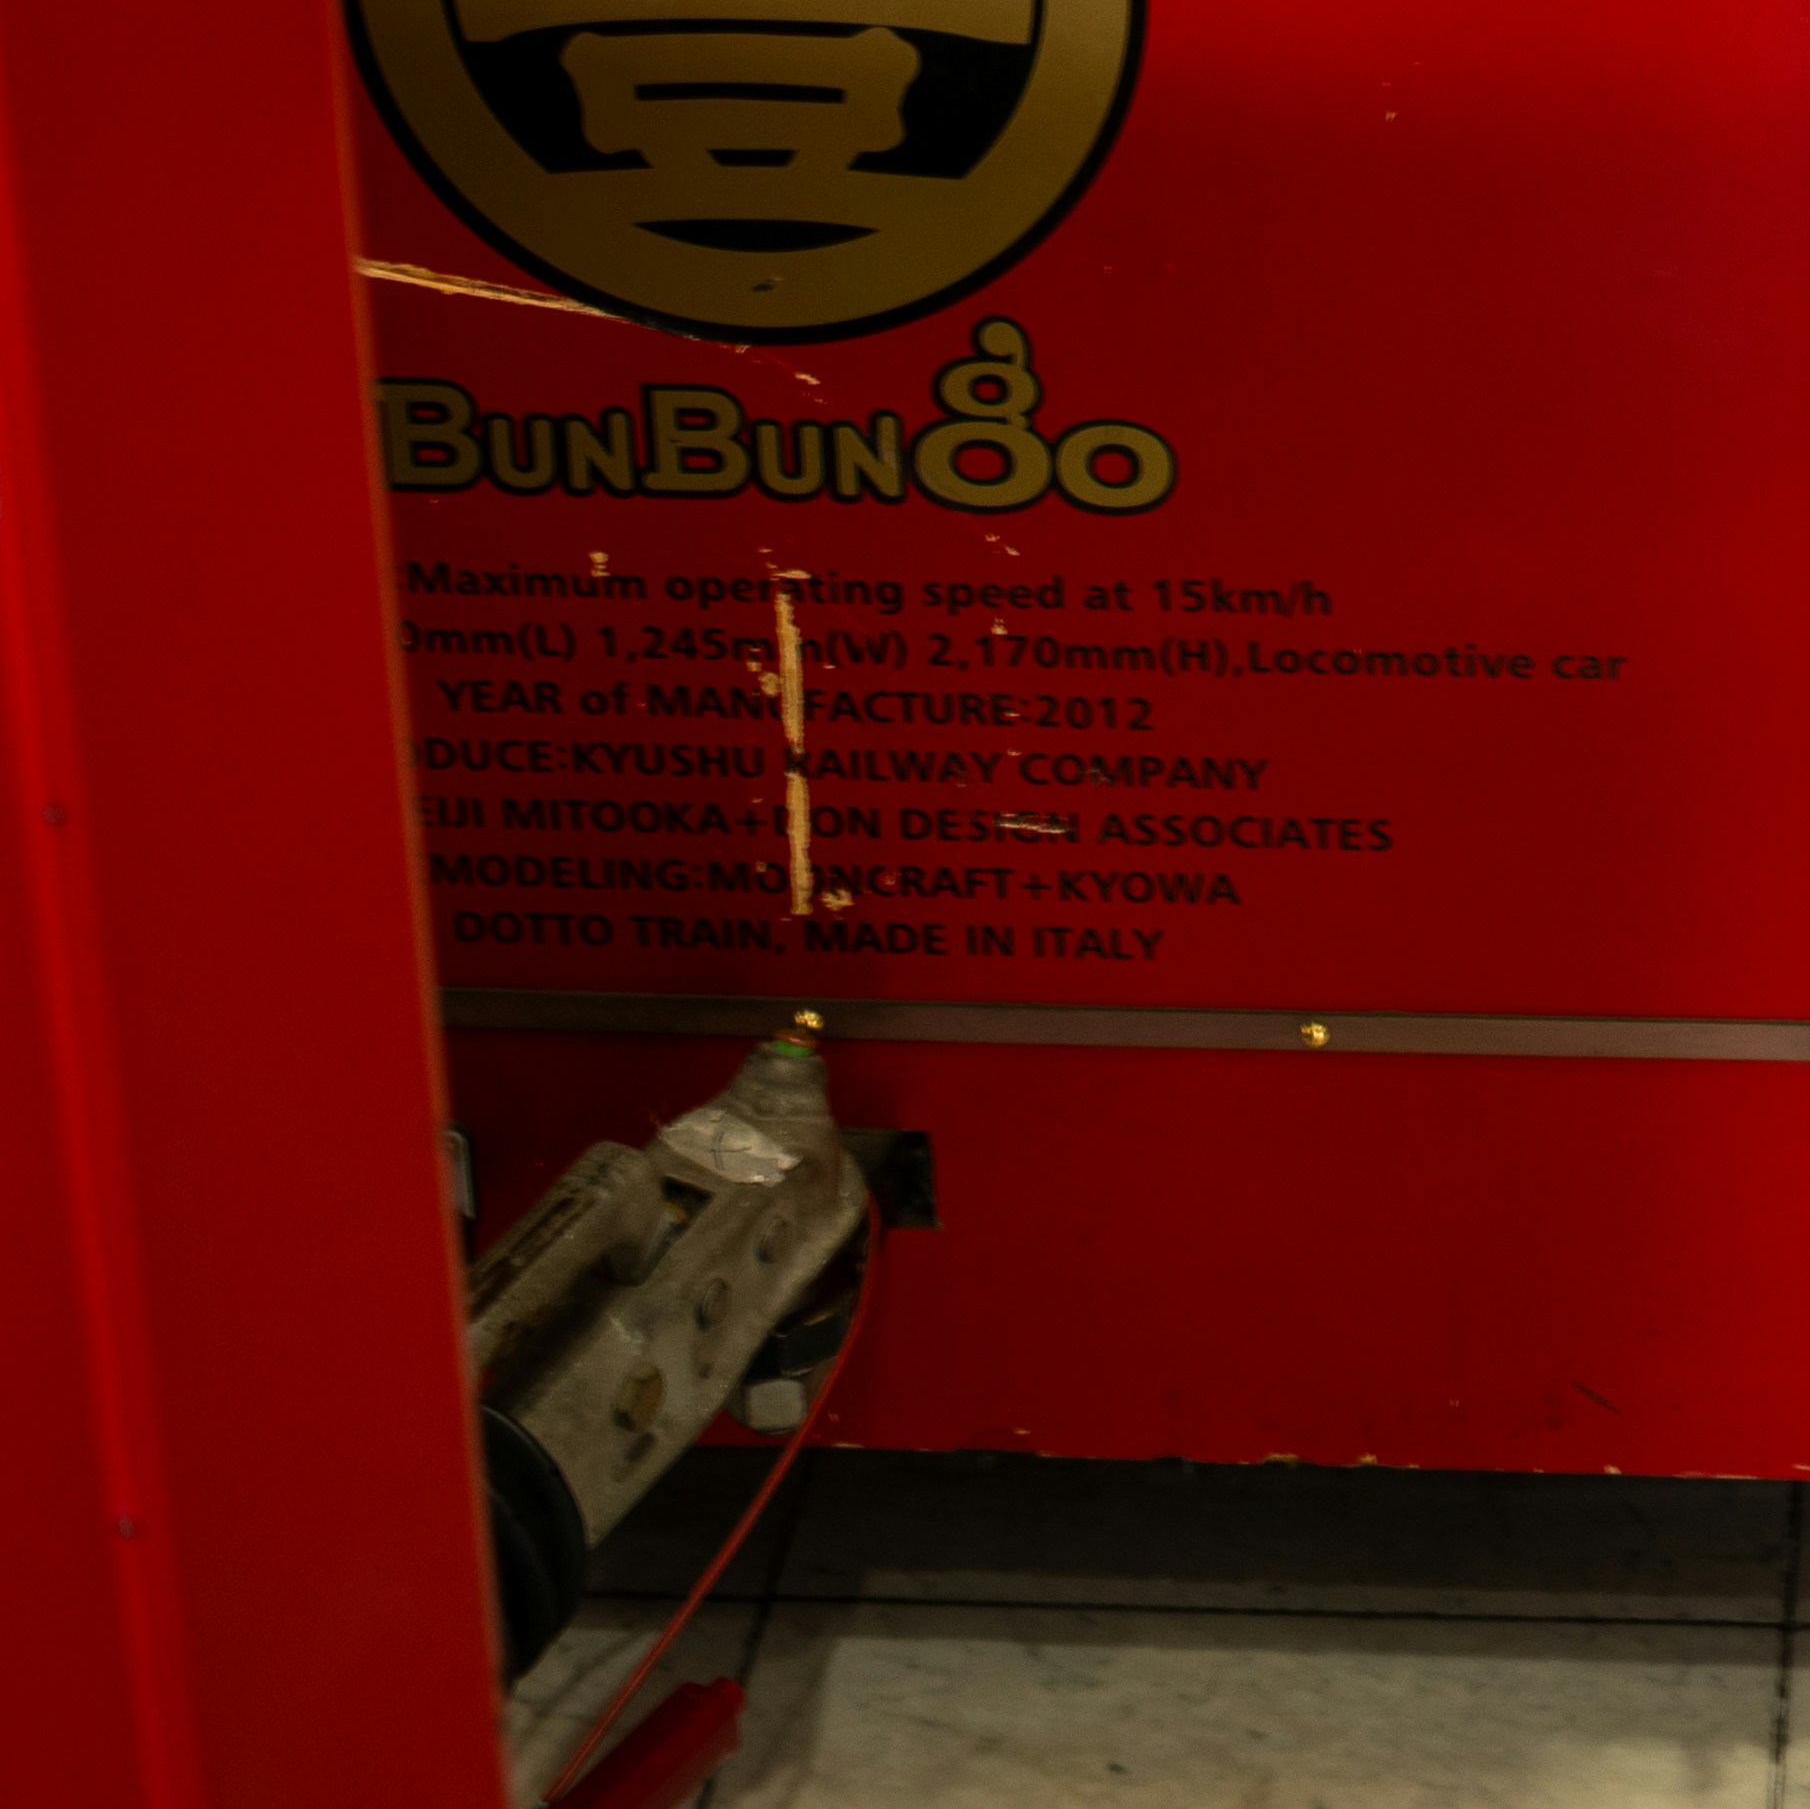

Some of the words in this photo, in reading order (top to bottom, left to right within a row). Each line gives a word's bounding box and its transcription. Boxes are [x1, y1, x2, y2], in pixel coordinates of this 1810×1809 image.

[663, 568, 905, 615] operating
[921, 575, 1065, 617] speed
[1082, 580, 1135, 612] at
[1151, 577, 1333, 618] 15km/h
[1550, 652, 1630, 681] car
[434, 679, 564, 714] YEAR
[578, 680, 630, 716] of
[783, 748, 1004, 783] RAILWAY
[1017, 752, 1271, 791] COMPANY
[898, 807, 1081, 844] DESIGN
[1096, 812, 1395, 853] ASSOCIATES
[452, 910, 615, 947] DOTTO
[803, 919, 949, 956] MADE
[965, 924, 1016, 958] IN
[1031, 926, 1167, 961] ITALY
